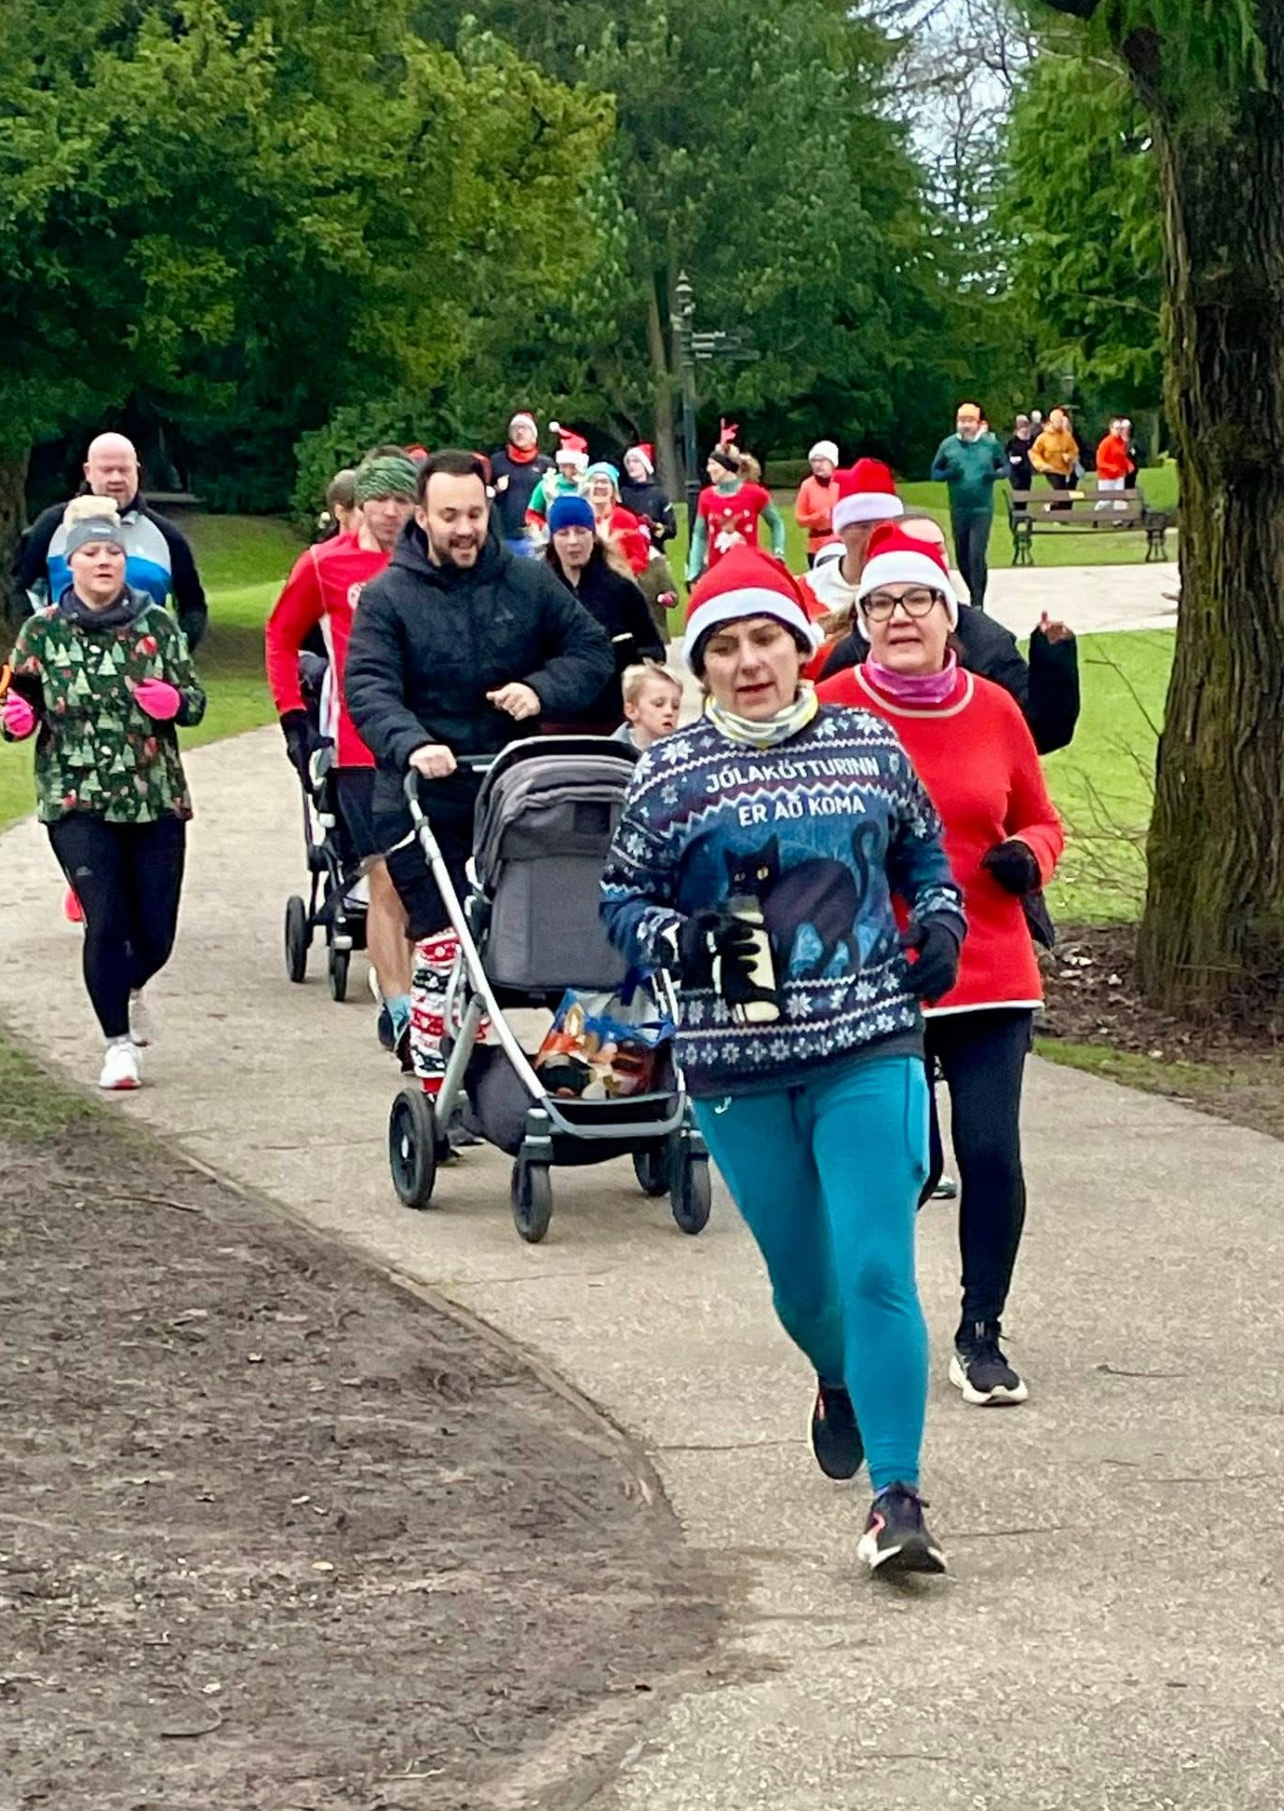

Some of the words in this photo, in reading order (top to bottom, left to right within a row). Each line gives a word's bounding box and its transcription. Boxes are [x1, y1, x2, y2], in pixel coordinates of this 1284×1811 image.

[705, 757, 880, 793] JÓLAKÖTTURINN
[738, 803, 768, 827] ER
[808, 795, 866, 816] KOMA
